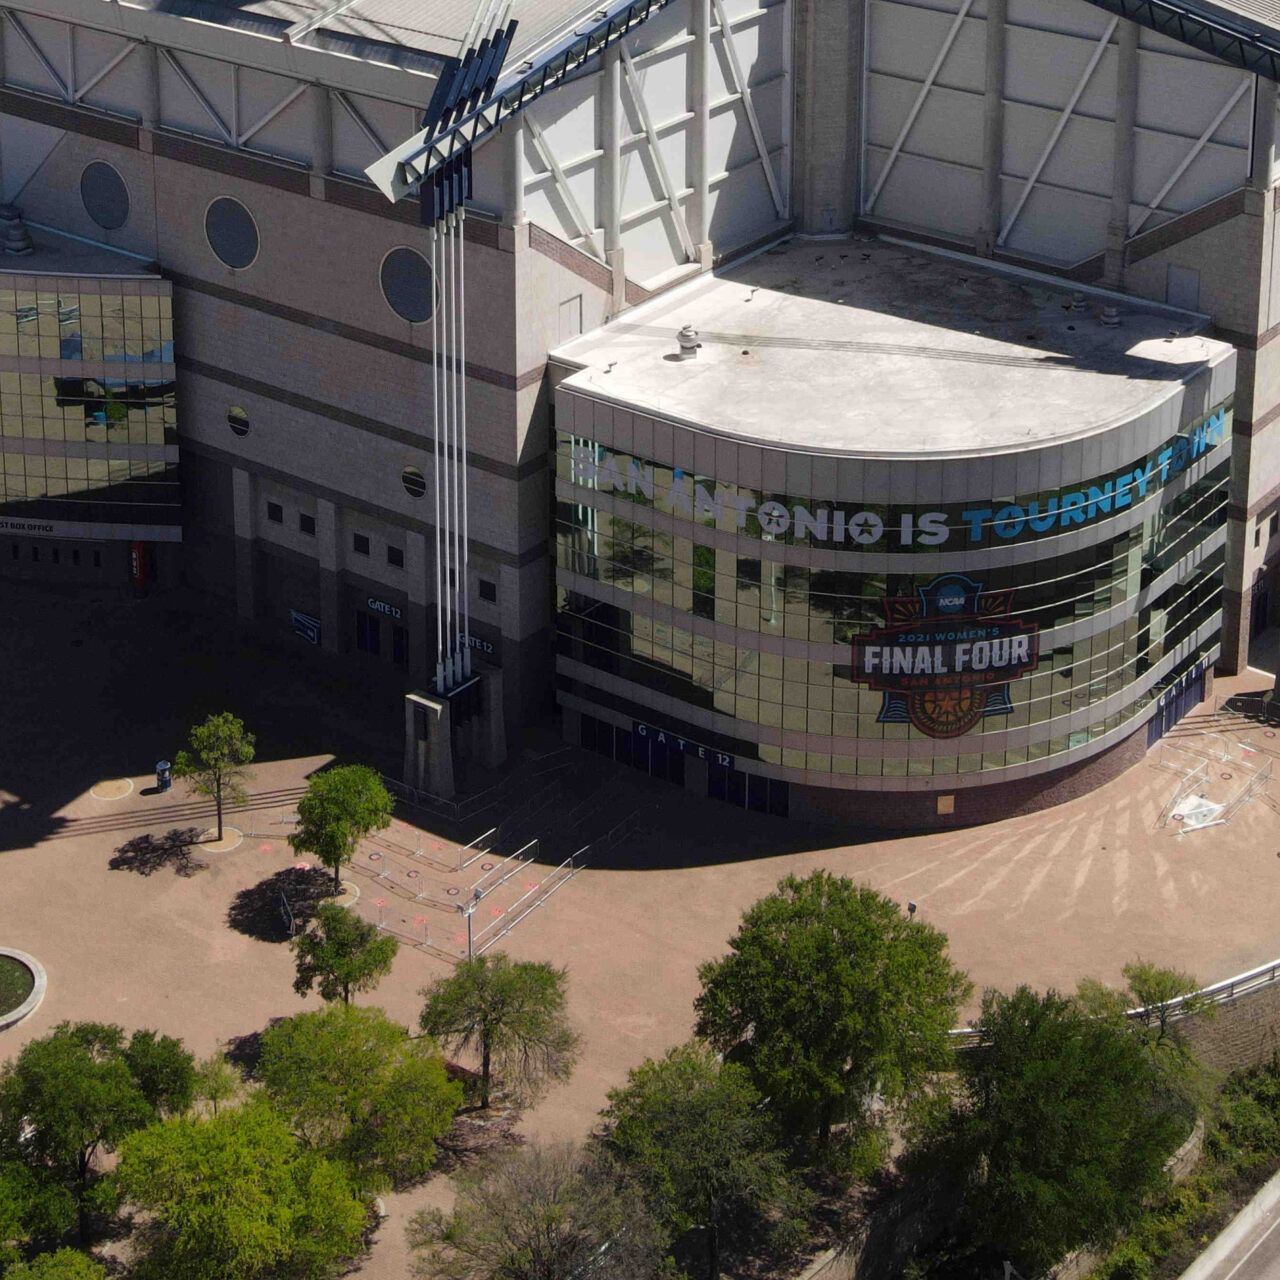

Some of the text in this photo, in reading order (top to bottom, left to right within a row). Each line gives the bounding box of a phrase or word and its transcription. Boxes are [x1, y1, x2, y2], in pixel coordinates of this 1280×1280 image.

[571, 407, 1226, 546] SAN ANTONIO IS TOURNEY TOWN
[10, 522, 26, 531] BOX
[27, 523, 54, 533] OFFICE
[367, 598, 401, 619] GATE 12
[938, 596, 966, 607] NCAA
[898, 626, 1001, 643] 2021 WOMEN'S
[483, 641, 494, 654] 12
[864, 634, 1031, 675] FINAL FOUR
[1160, 667, 1196, 706] GATE
[638, 724, 730, 767] GATE 12
